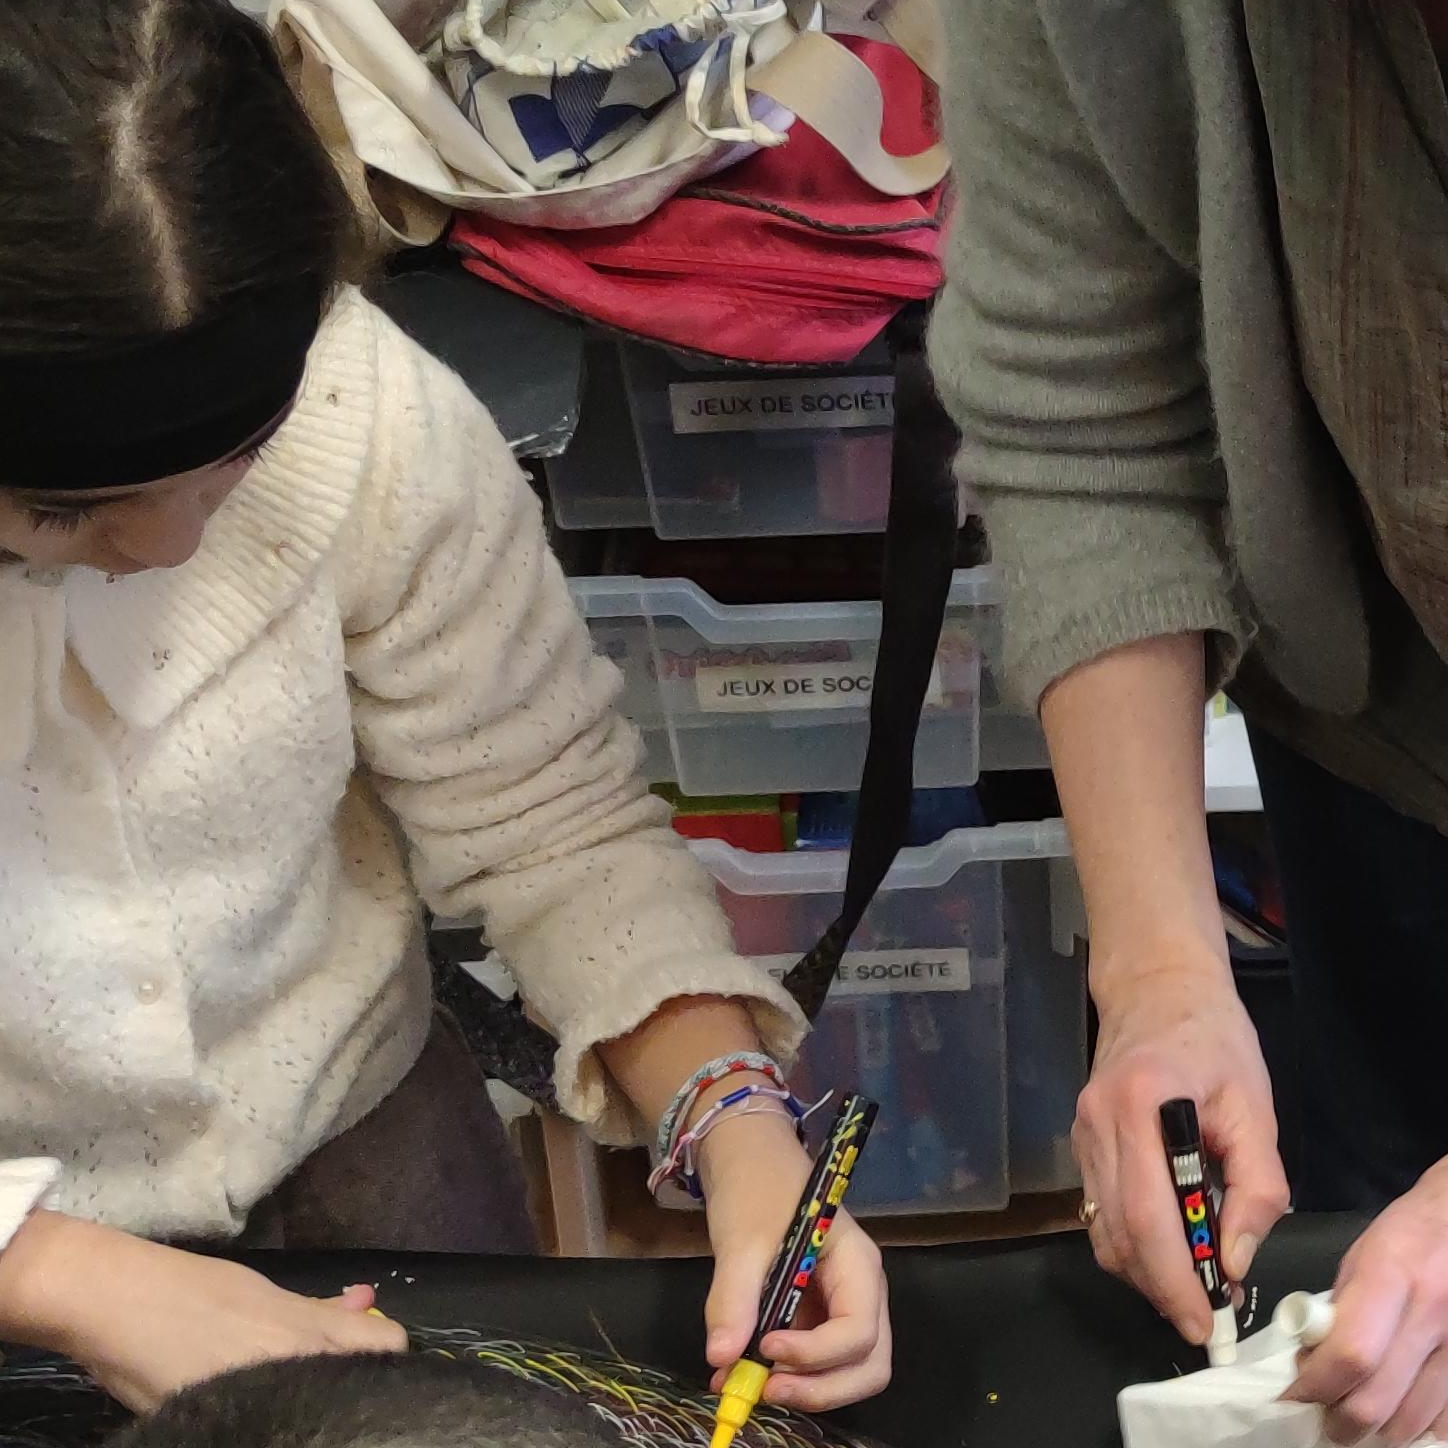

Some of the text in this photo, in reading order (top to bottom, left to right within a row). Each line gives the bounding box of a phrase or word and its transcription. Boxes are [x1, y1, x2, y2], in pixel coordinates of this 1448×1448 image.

[691, 389, 896, 416] JEUX DE SOCIÉT
[717, 675, 872, 697] JEUX DE SOC
[834, 960, 951, 981] E SOCIÉTÉ
